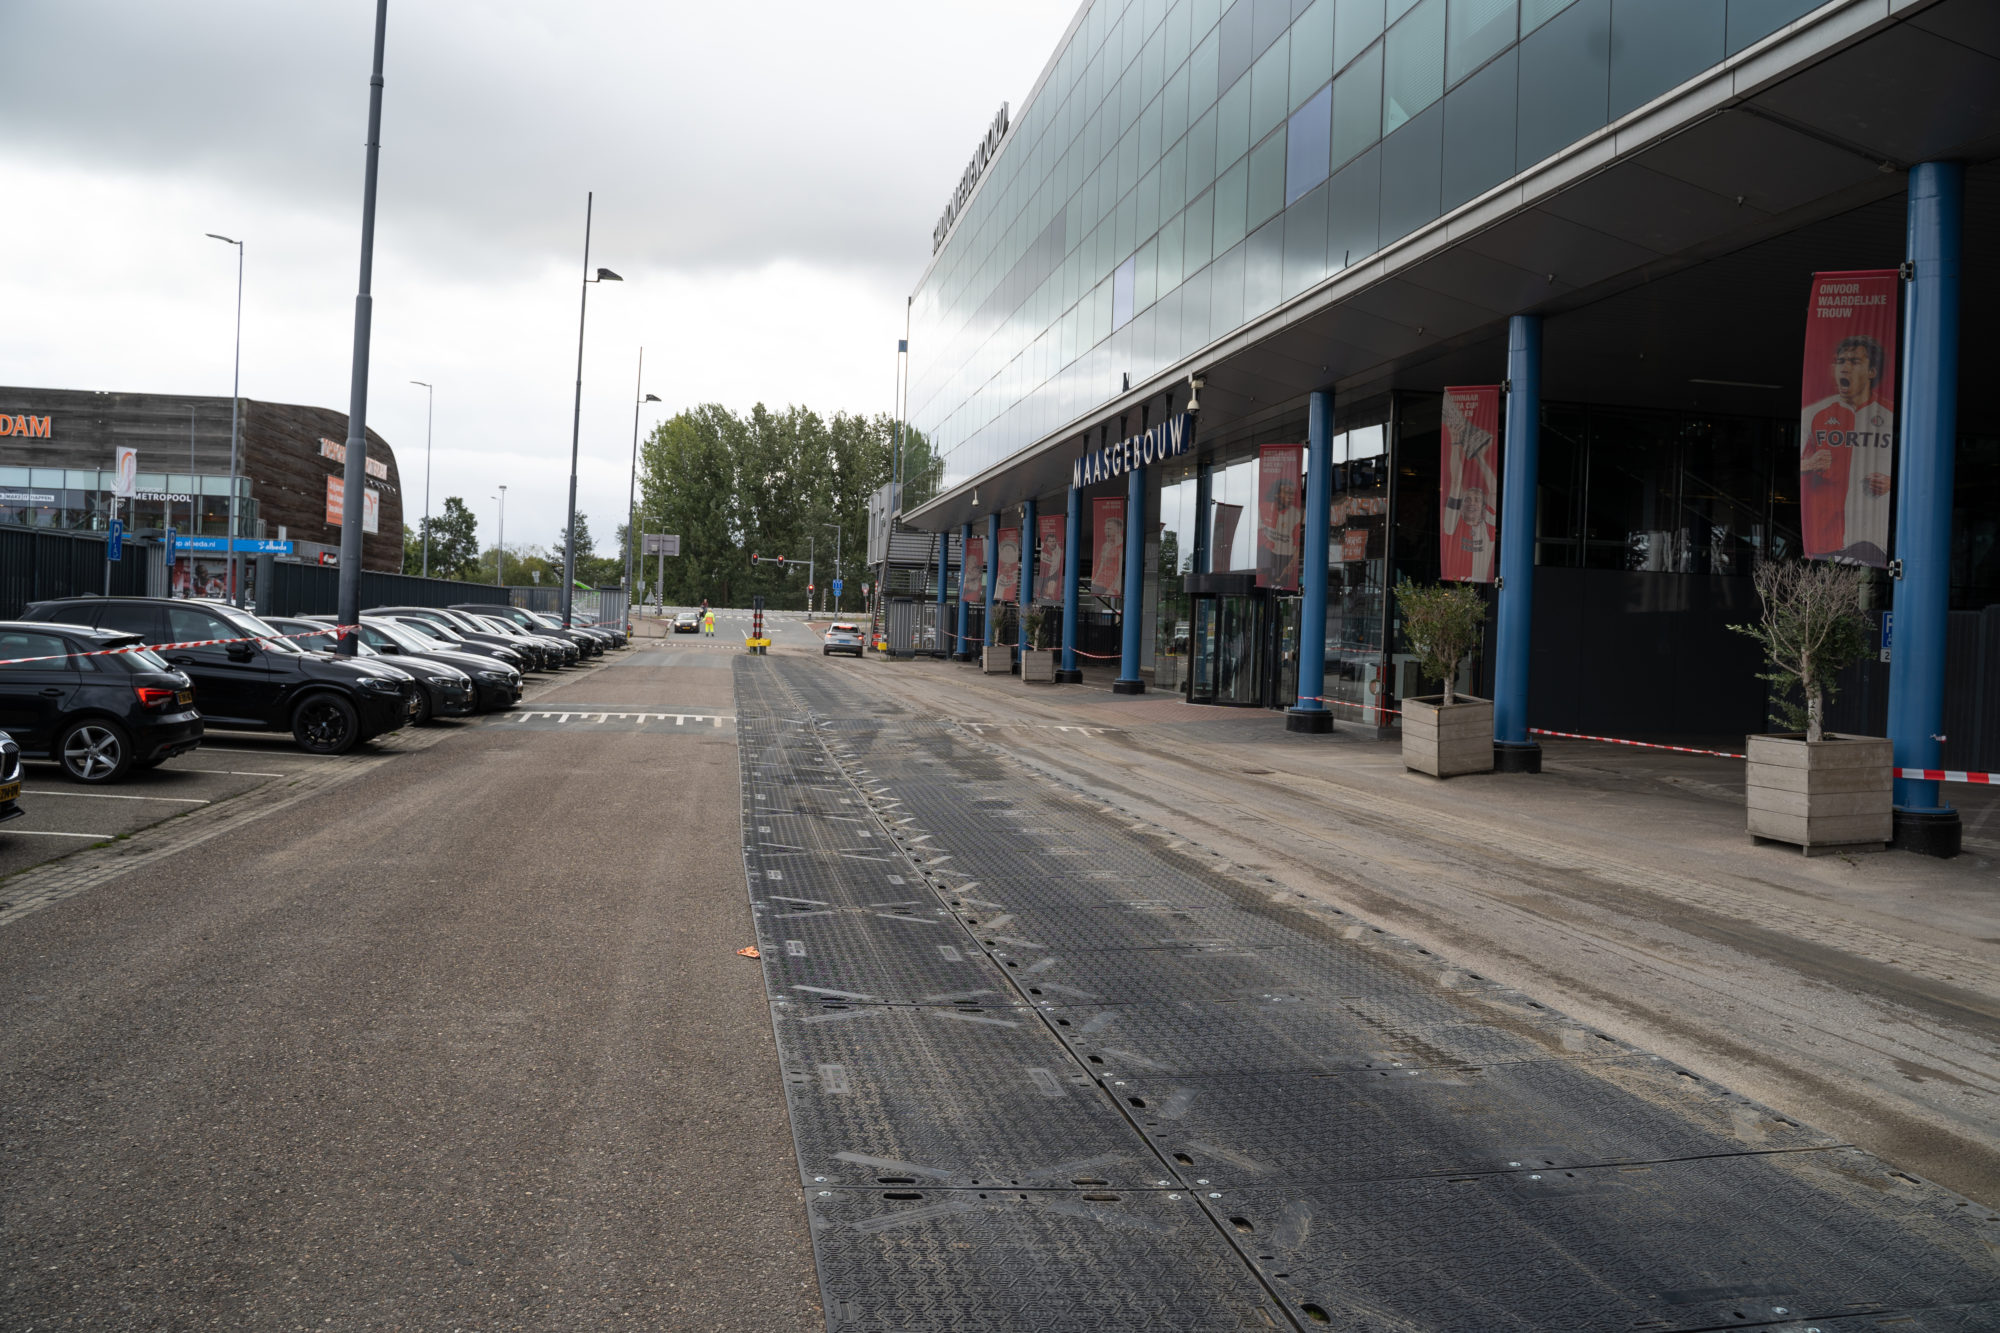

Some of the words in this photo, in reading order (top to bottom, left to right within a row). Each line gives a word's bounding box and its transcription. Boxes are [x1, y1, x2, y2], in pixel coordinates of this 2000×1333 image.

[1820, 284, 1859, 294] ONVOOR
[1818, 295, 1887, 306] WAARDELIJKE
[1816, 308, 1852, 318] TROUW
[1816, 430, 1891, 448] FORTIS
[1072, 413, 1185, 490] MAASGEBOUW
[134, 492, 192, 503] METROPOOL
[113, 524, 121, 544] P
[184, 540, 216, 548] albeda.nl
[265, 540, 287, 551] albeda
